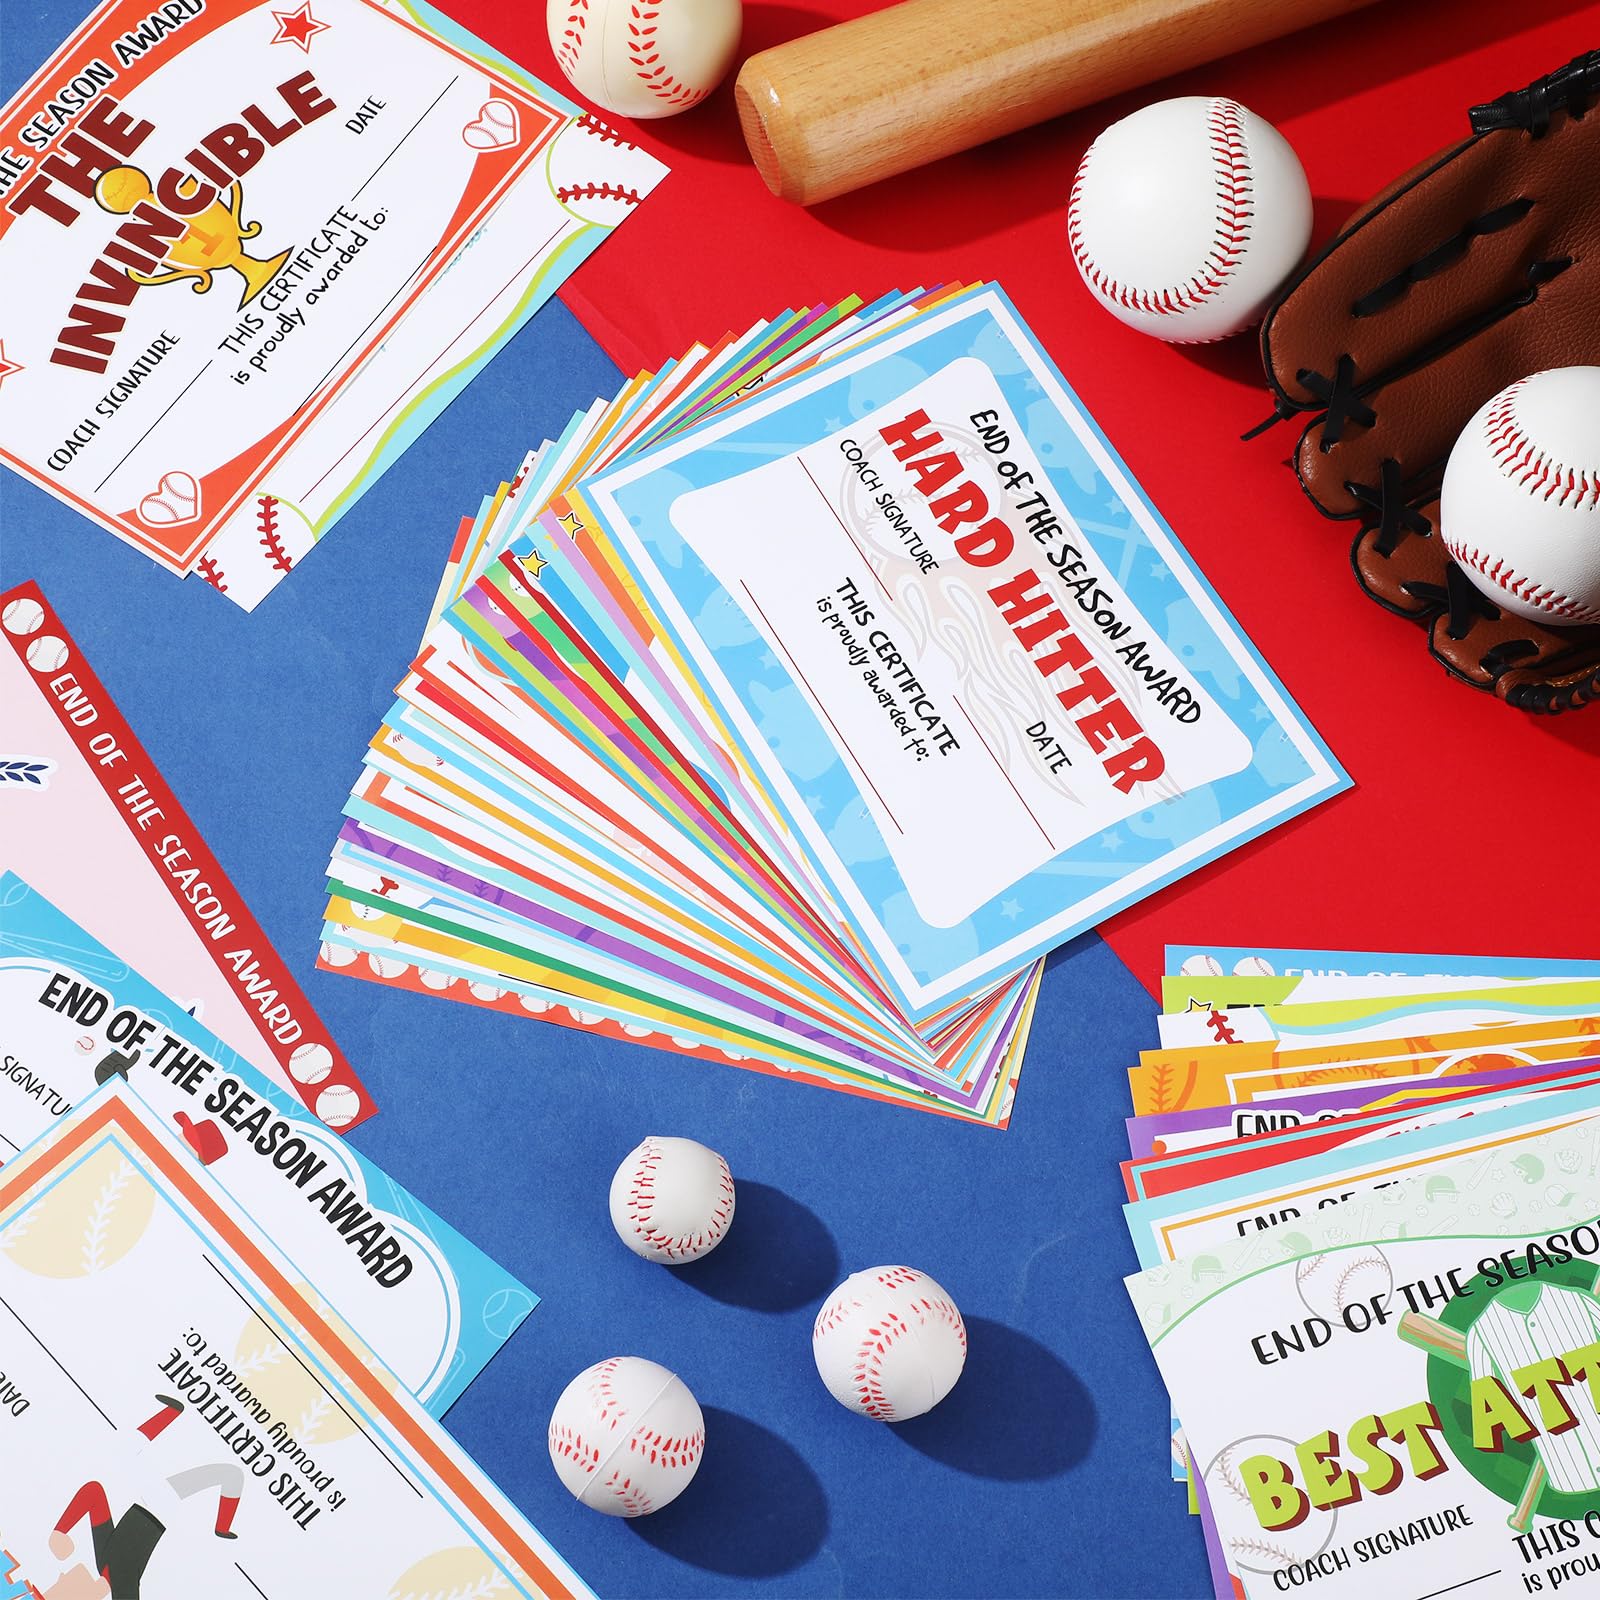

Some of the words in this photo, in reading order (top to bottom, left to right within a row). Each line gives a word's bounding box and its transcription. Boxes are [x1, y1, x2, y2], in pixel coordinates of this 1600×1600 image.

[0, 149, 31, 195] HE
[22, 61, 115, 148] SEASON
[115, 0, 203, 65] AWARD
[345, 95, 387, 135] DATE
[9, 97, 156, 226] THE
[50, 69, 337, 374] INVINCIBLE
[218, 314, 263, 353] THIS
[261, 212, 357, 311] CERTIFICATE
[234, 371, 250, 384] is
[250, 308, 305, 372] proudly
[306, 232, 368, 304] awarded
[364, 208, 388, 230] to:
[48, 420, 100, 471] COACH
[96, 331, 180, 418] SIGNATURE
[840, 440, 883, 491] COACH
[876, 494, 939, 574] SIGNATURE
[817, 599, 831, 612] is
[878, 409, 1014, 567] HARD
[987, 568, 1165, 794] HITTER
[970, 410, 1009, 454] END
[1018, 491, 1062, 544] THE
[1047, 544, 1130, 640] SEASON
[1116, 642, 1200, 723] AWARD
[822, 614, 870, 665] proudly
[837, 577, 874, 626] THIS
[869, 631, 960, 756] CERTIFICATE
[864, 670, 910, 736] awarded
[904, 739, 929, 761] to:
[1026, 721, 1072, 774] DATE
[50, 673, 97, 726] END
[90, 733, 127, 767] OF
[119, 774, 164, 830] THE
[154, 835, 235, 939] SEASON
[225, 950, 302, 1044] AWARD
[0, 1056, 72, 1115] SIGNATU
[39, 973, 108, 1026] END
[107, 1011, 156, 1050] OF
[149, 1035, 214, 1095] THE
[205, 1079, 327, 1188] SEASON
[307, 1178, 412, 1288] AWARD
[182, 1326, 206, 1354] to:
[1251, 1318, 1331, 1364] END
[1343, 1294, 1392, 1332] OF
[1397, 1268, 1474, 1313] THE
[1477, 1220, 1600, 1287] SEASO
[158, 1348, 274, 1476] CERTIFICATE
[199, 1358, 270, 1423] awarded
[267, 1422, 334, 1492] proudly
[269, 1473, 320, 1530] THIS
[328, 1491, 346, 1509] is
[1241, 1403, 1447, 1531] BEST
[1274, 1548, 1350, 1590] COACH
[1354, 1505, 1473, 1562] SIGNATURE
[1512, 1518, 1580, 1563] THIS
[1522, 1573, 1542, 1593] is
